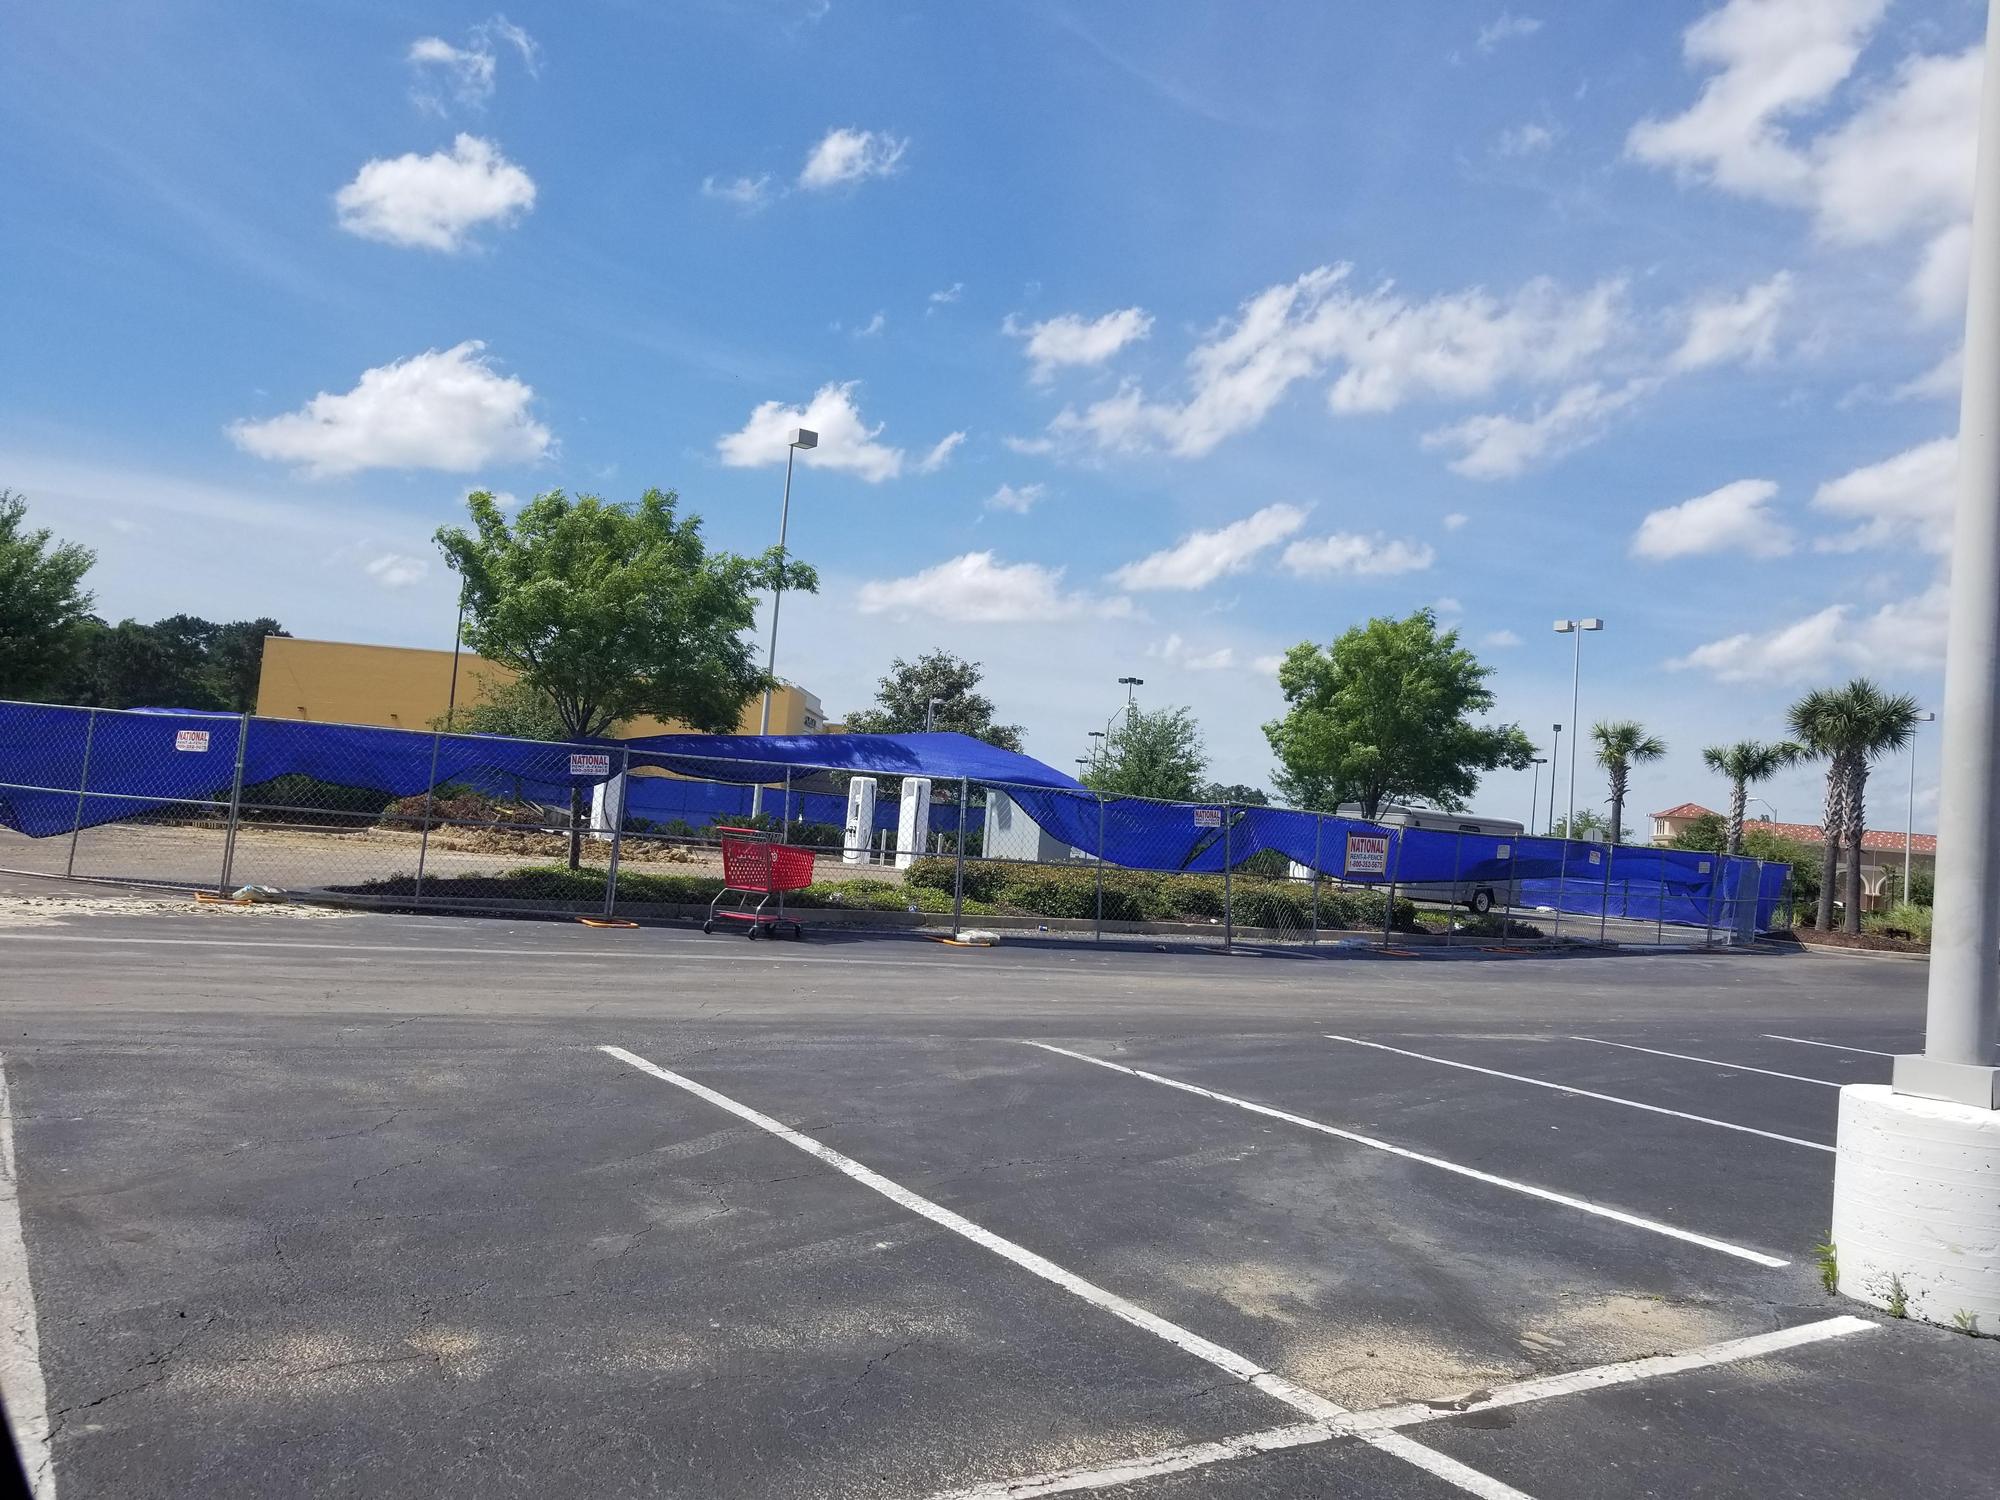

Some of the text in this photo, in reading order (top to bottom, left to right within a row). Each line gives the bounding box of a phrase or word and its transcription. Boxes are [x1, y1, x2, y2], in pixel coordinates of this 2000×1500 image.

[178, 732, 207, 741] NATIONAL
[572, 756, 608, 765] NATIONAL
[1196, 811, 1220, 819] NATIONAL
[1351, 839, 1384, 853] NATIONAL
